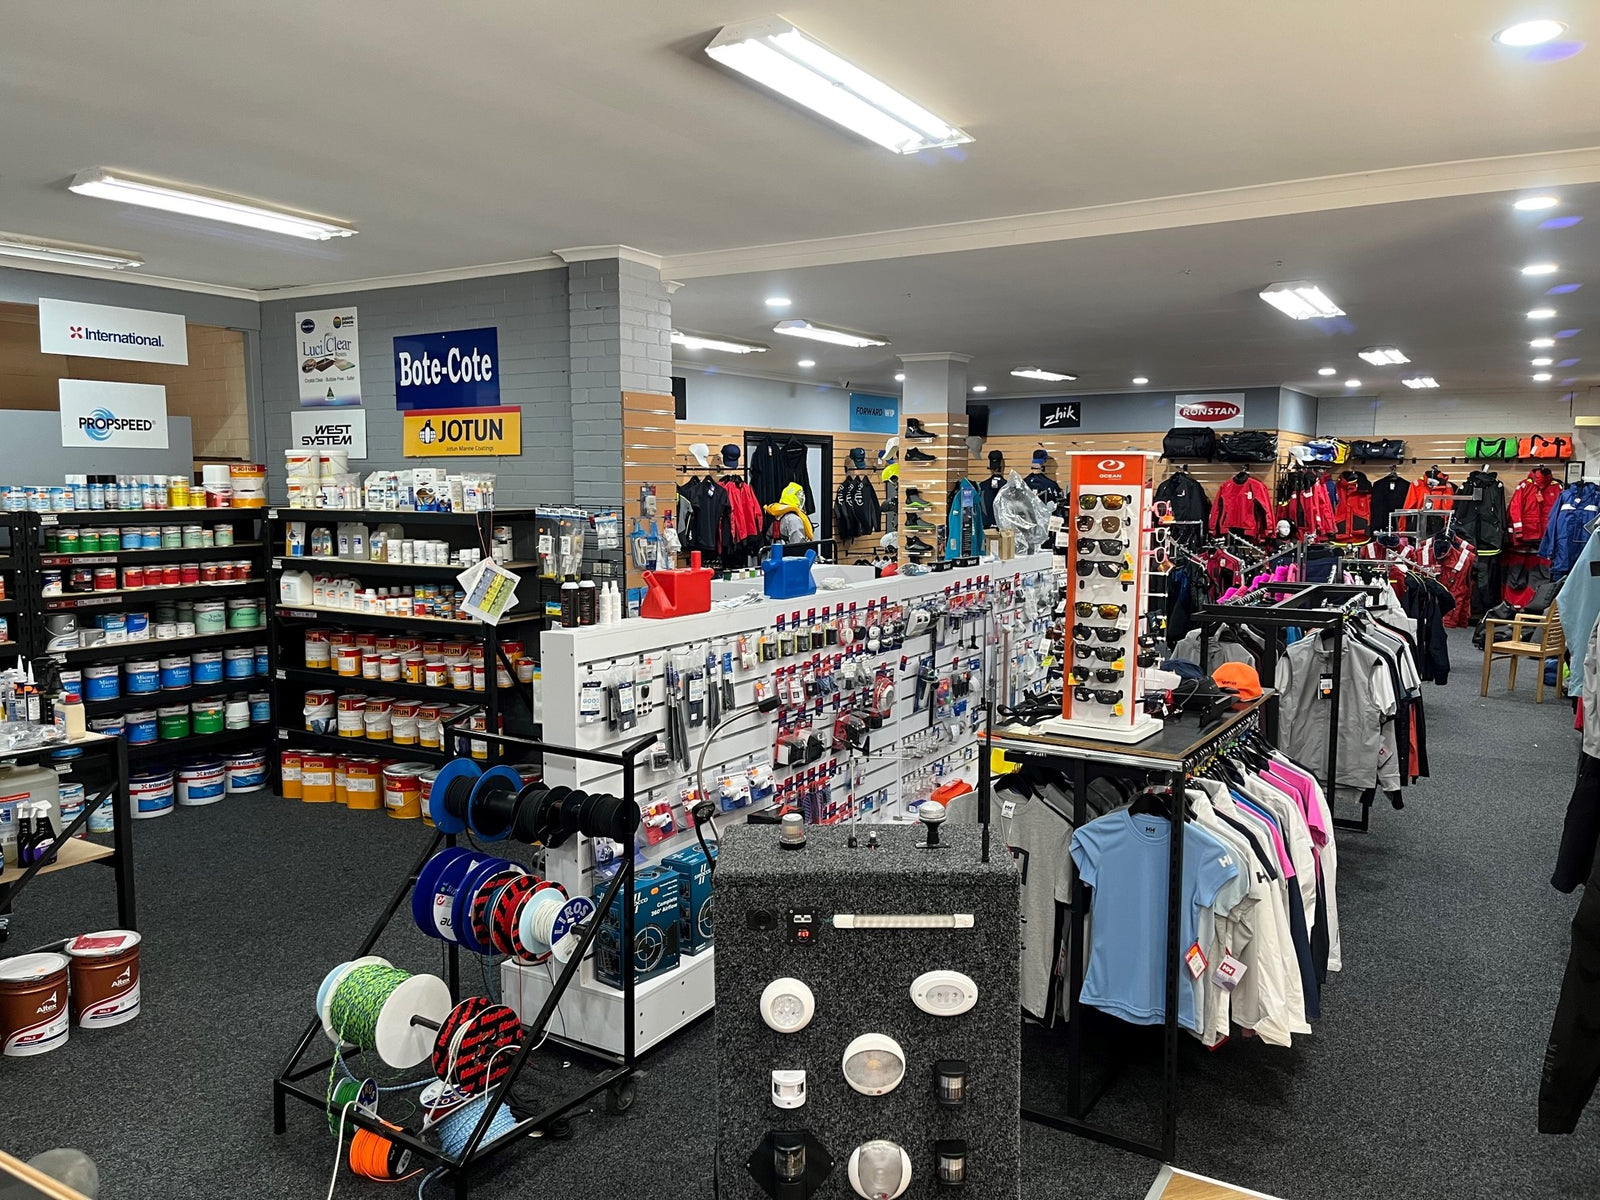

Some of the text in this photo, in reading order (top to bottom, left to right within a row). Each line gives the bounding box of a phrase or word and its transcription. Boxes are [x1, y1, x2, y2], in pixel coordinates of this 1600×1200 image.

[398, 346, 493, 387] Bote-Cote
[856, 406, 883, 416] FORWARD
[1182, 407, 1238, 416] RONSTAN
[315, 425, 352, 434] WEST
[438, 418, 503, 443] JOTUN
[302, 435, 352, 446] SYSTEM
[444, 646, 460, 655] OTUN
[393, 708, 409, 717] OTUN
[420, 710, 434, 719] OTUN
[657, 896, 678, 908] Complete
[662, 903, 678, 913] Airflow
[554, 901, 589, 935] LIROS
[1222, 963, 1235, 974] HH
[111, 978, 131, 988] Altex
[36, 1003, 57, 1014] Altex
[481, 1007, 512, 1026] Marlow
